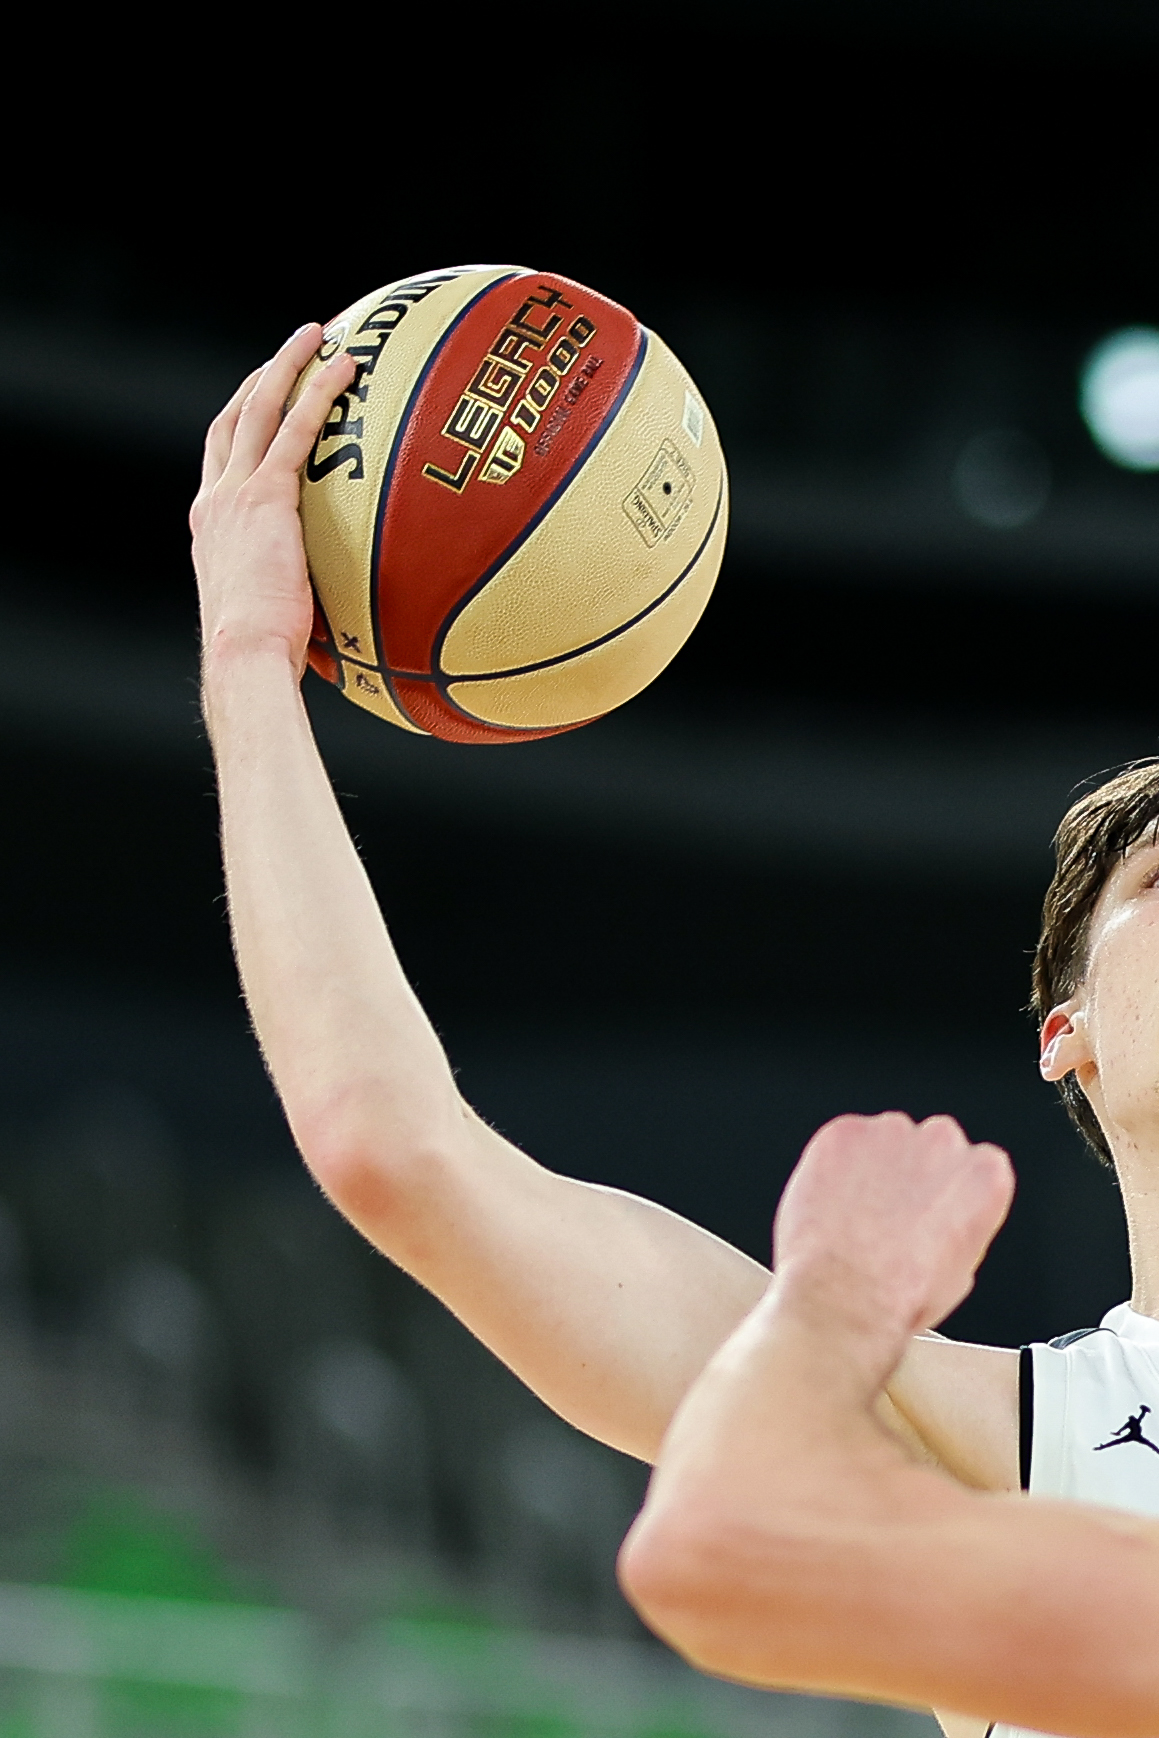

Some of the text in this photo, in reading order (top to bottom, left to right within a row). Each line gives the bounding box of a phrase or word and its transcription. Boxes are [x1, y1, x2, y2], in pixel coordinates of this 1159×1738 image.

[306, 269, 470, 484] SPALDIN
[421, 285, 575, 495] LEGACY
[509, 313, 598, 434] 1000
